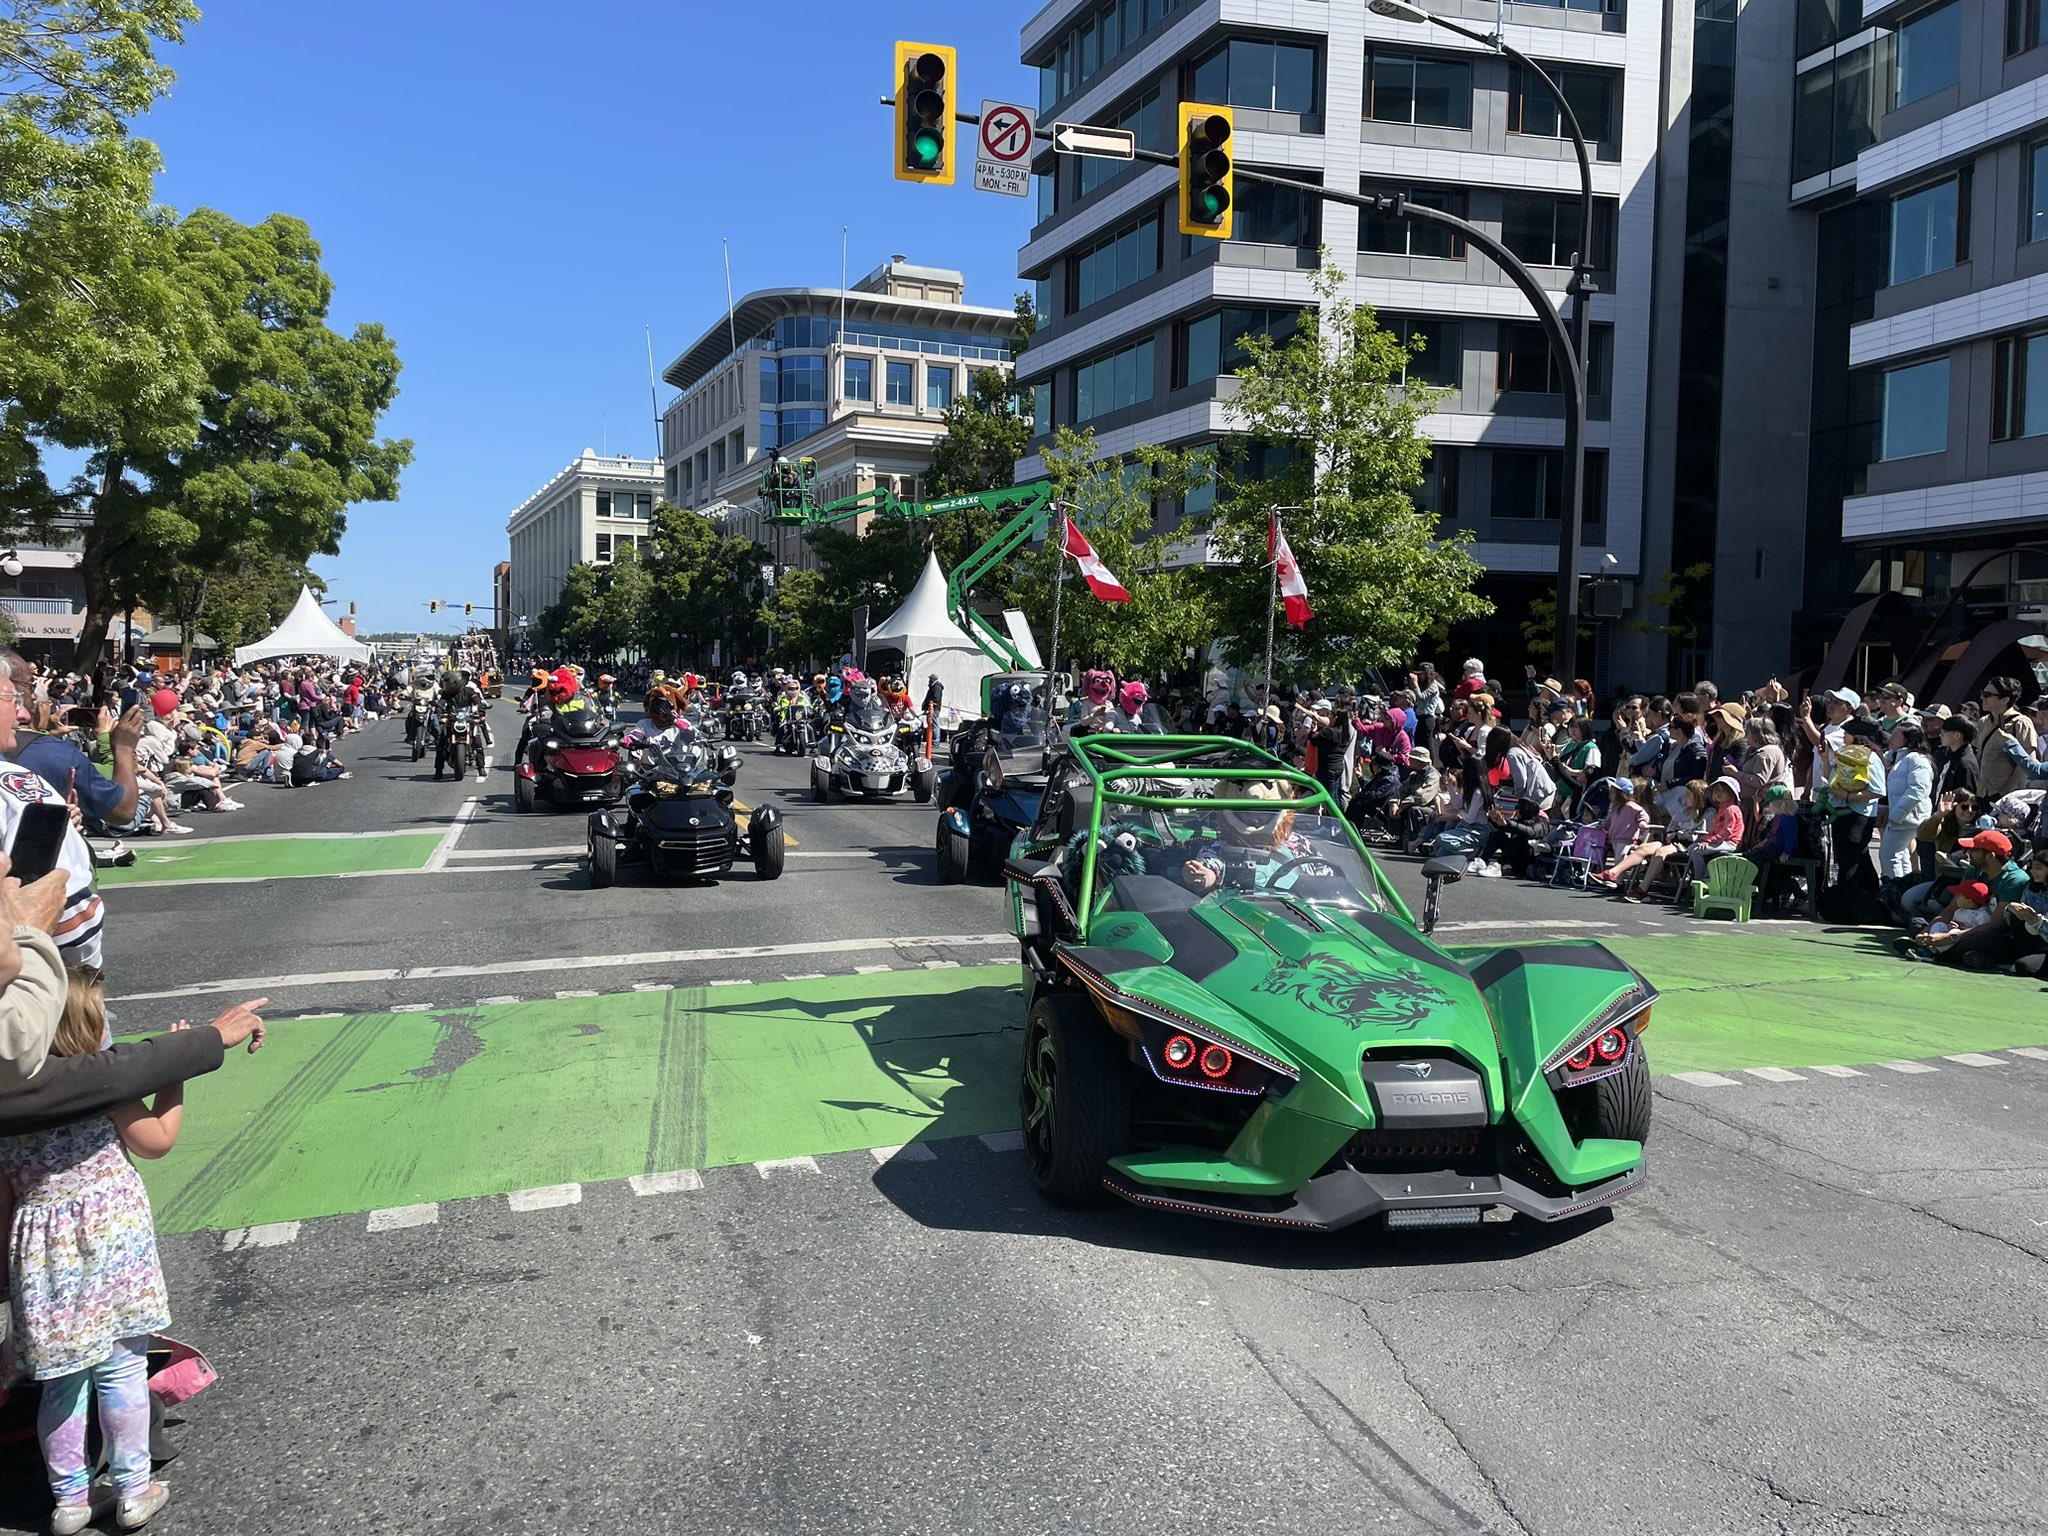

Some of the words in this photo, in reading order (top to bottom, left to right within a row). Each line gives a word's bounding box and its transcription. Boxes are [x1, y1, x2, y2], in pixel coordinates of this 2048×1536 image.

[982, 177, 1001, 189] MON.
[1007, 181, 1020, 193] FRI.
[950, 498, 967, 507] Z-45
[968, 496, 979, 504] XC
[1391, 1091, 1470, 1105] POLARIS
